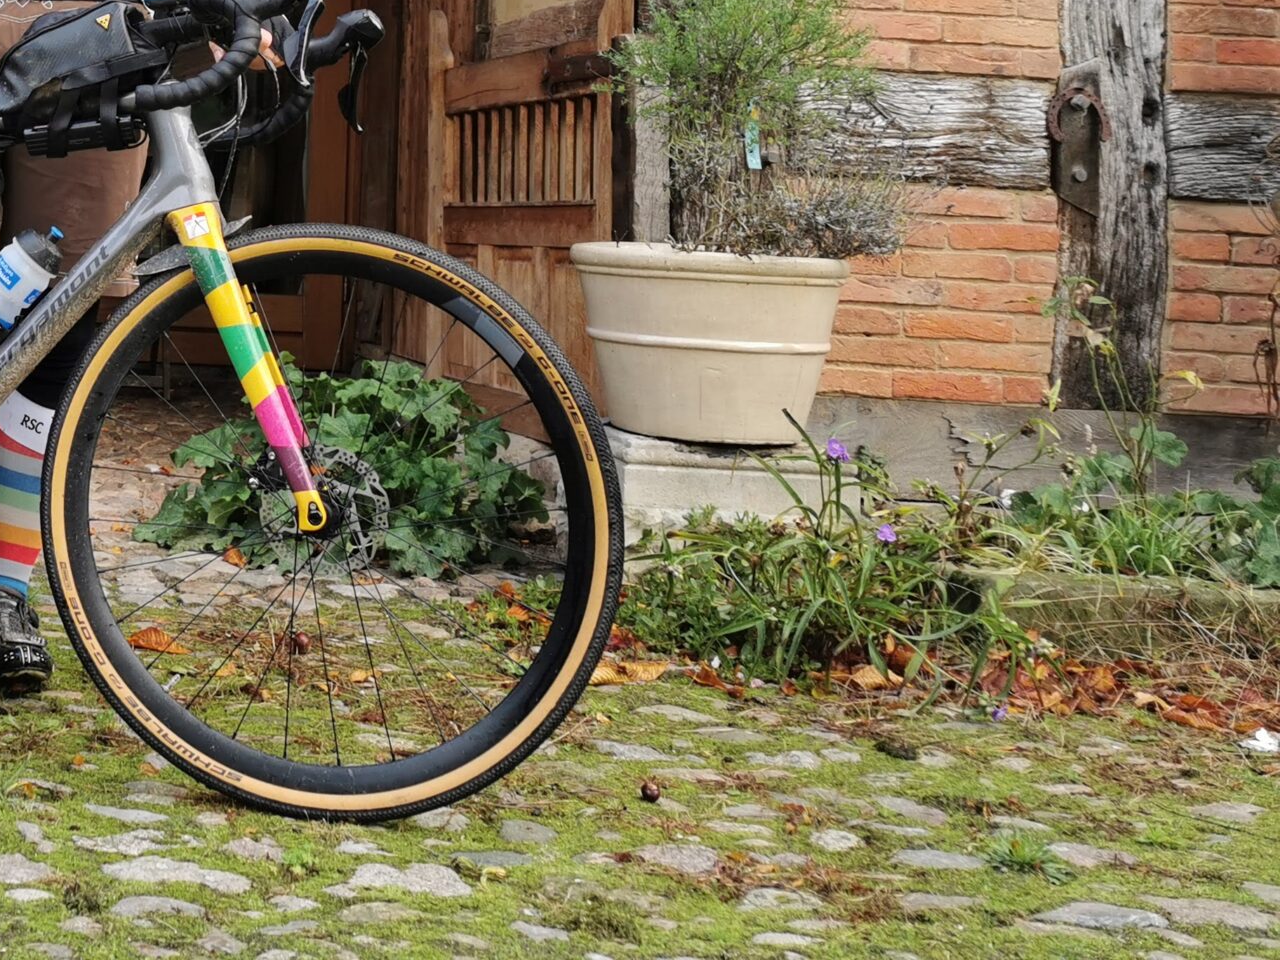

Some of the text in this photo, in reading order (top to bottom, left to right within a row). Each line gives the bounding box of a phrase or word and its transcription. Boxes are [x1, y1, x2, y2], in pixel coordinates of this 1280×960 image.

[20, 414, 44, 434] RSC
[393, 252, 582, 426] SCHWALBE G-ONE
[68, 596, 243, 783] SCHWALBE G-ONE
